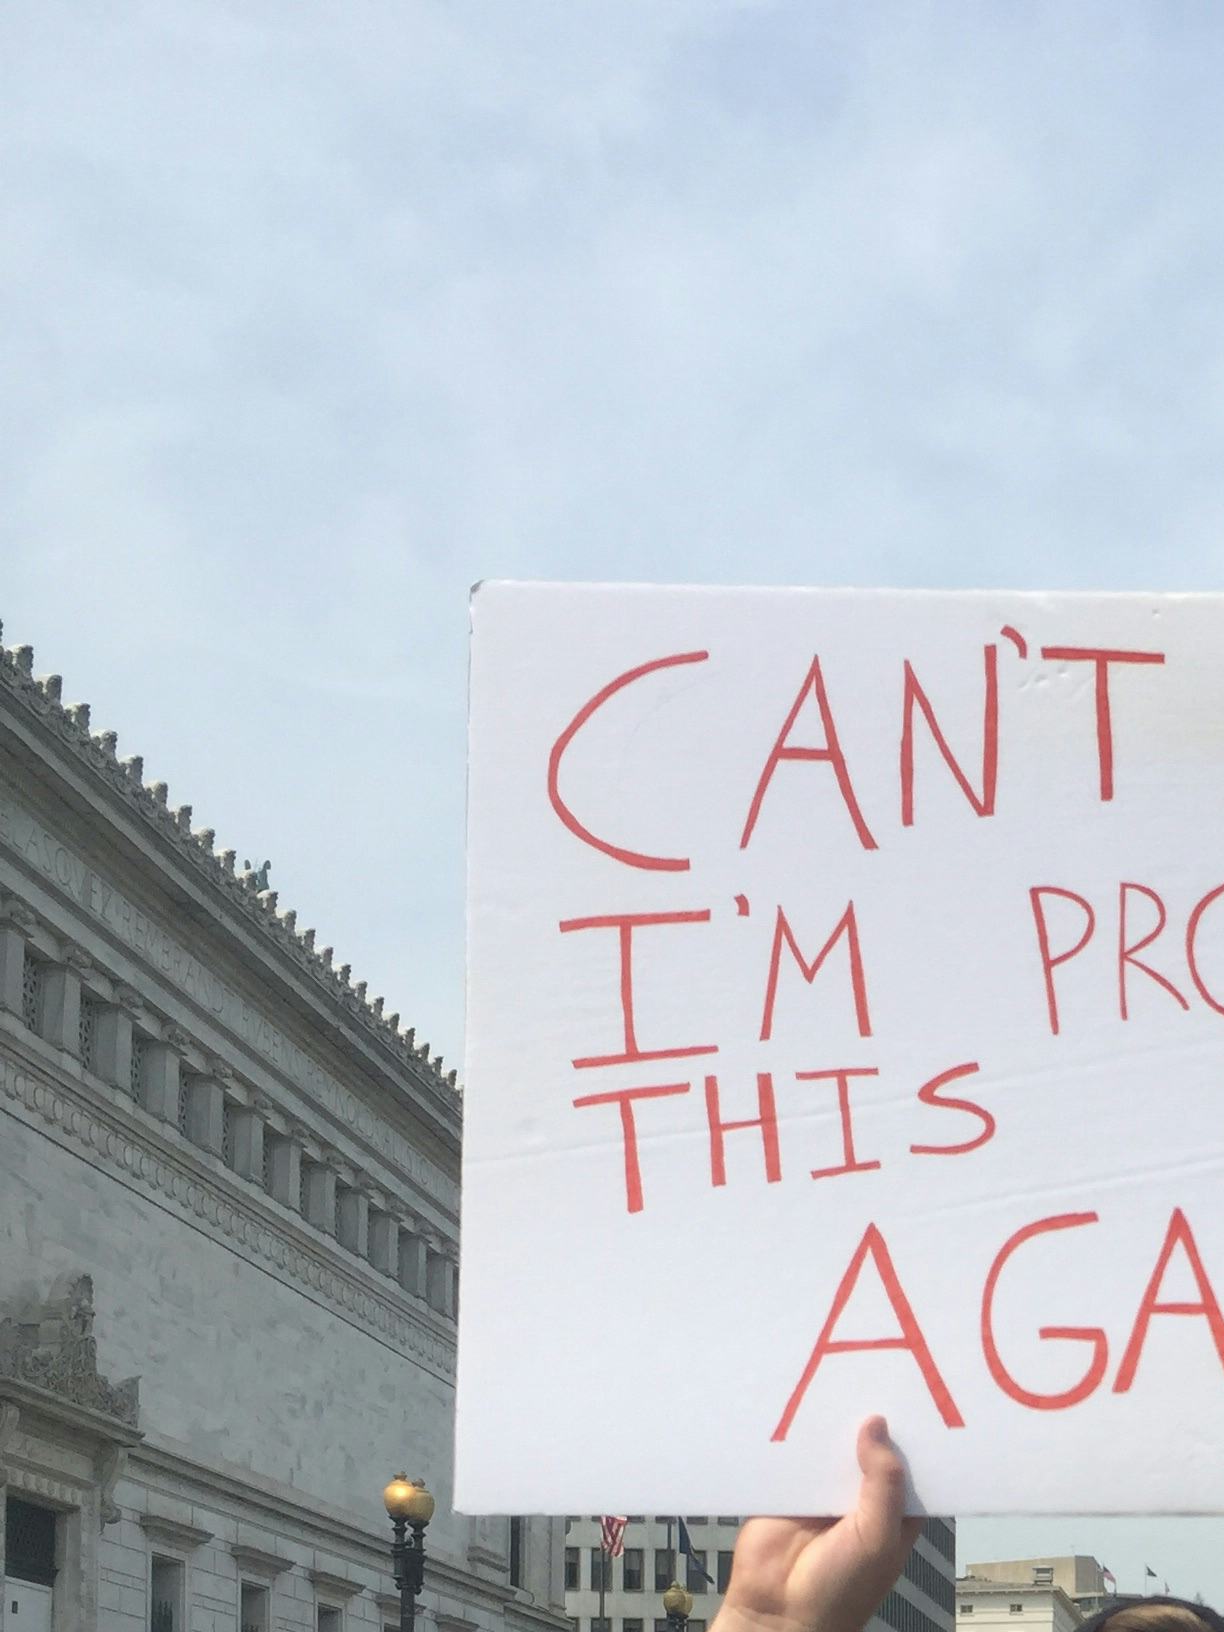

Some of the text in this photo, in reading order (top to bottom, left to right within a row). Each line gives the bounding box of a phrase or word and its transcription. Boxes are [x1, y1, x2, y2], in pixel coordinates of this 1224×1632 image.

[547, 625, 1166, 873] CAN'T
[559, 895, 873, 1069] I'M
[572, 1061, 997, 1215] THIS
